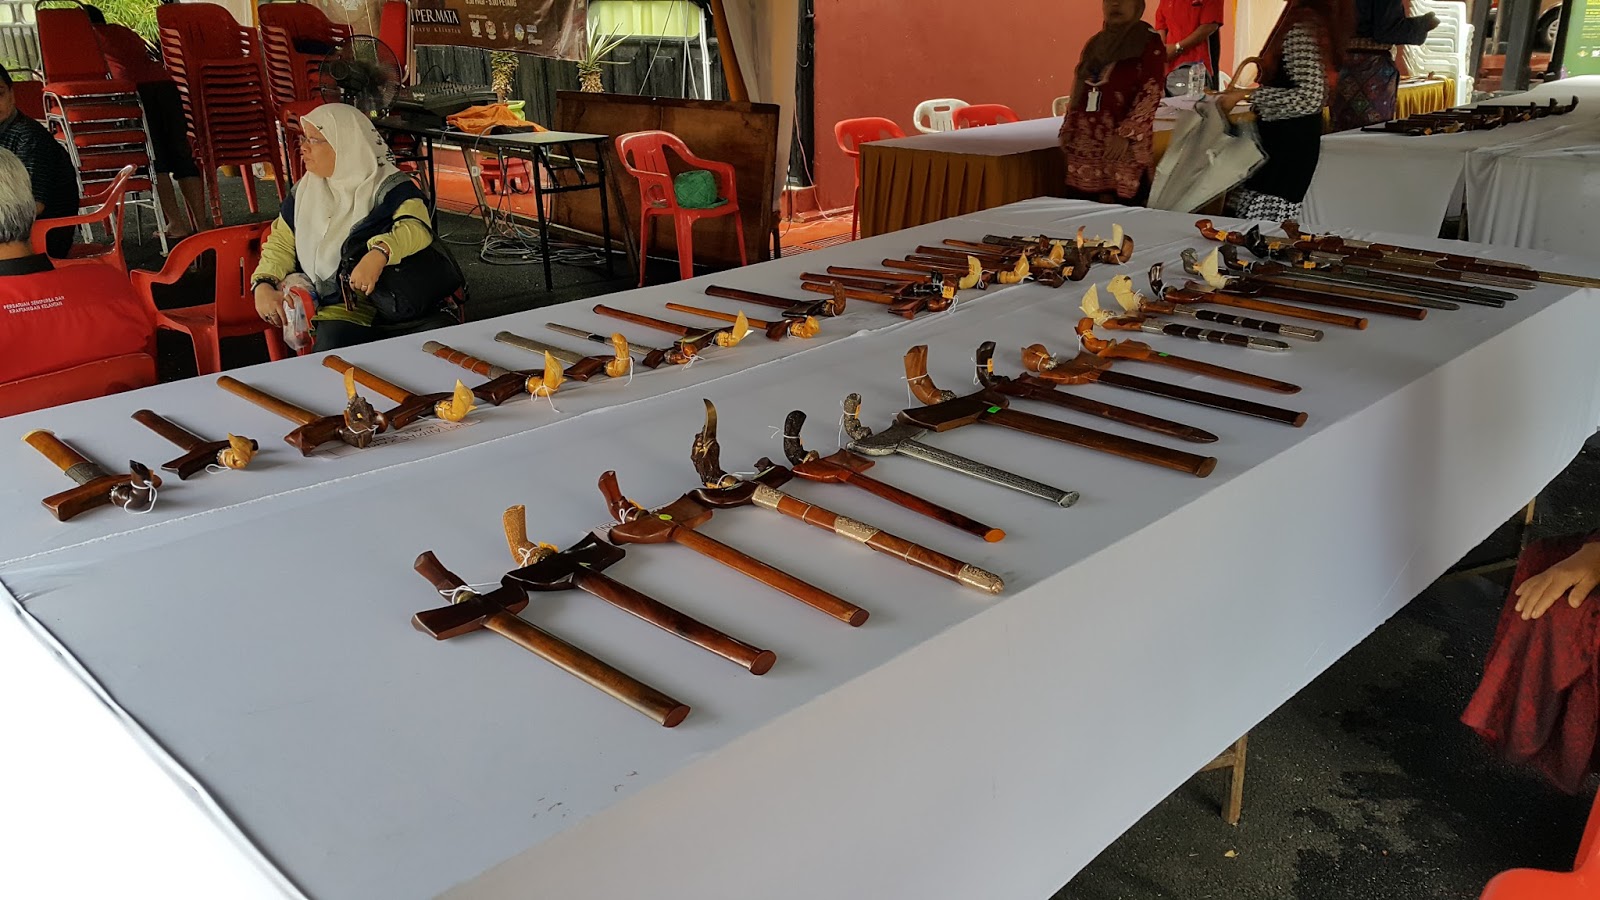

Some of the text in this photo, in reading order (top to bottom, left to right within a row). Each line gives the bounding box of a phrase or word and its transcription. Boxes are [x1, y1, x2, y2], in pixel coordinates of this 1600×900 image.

[415, 8, 460, 24] PERMATA
[3, 301, 31, 310] PERSATUAN
[8, 301, 63, 314] KRAFTANGAN KELANTAN
